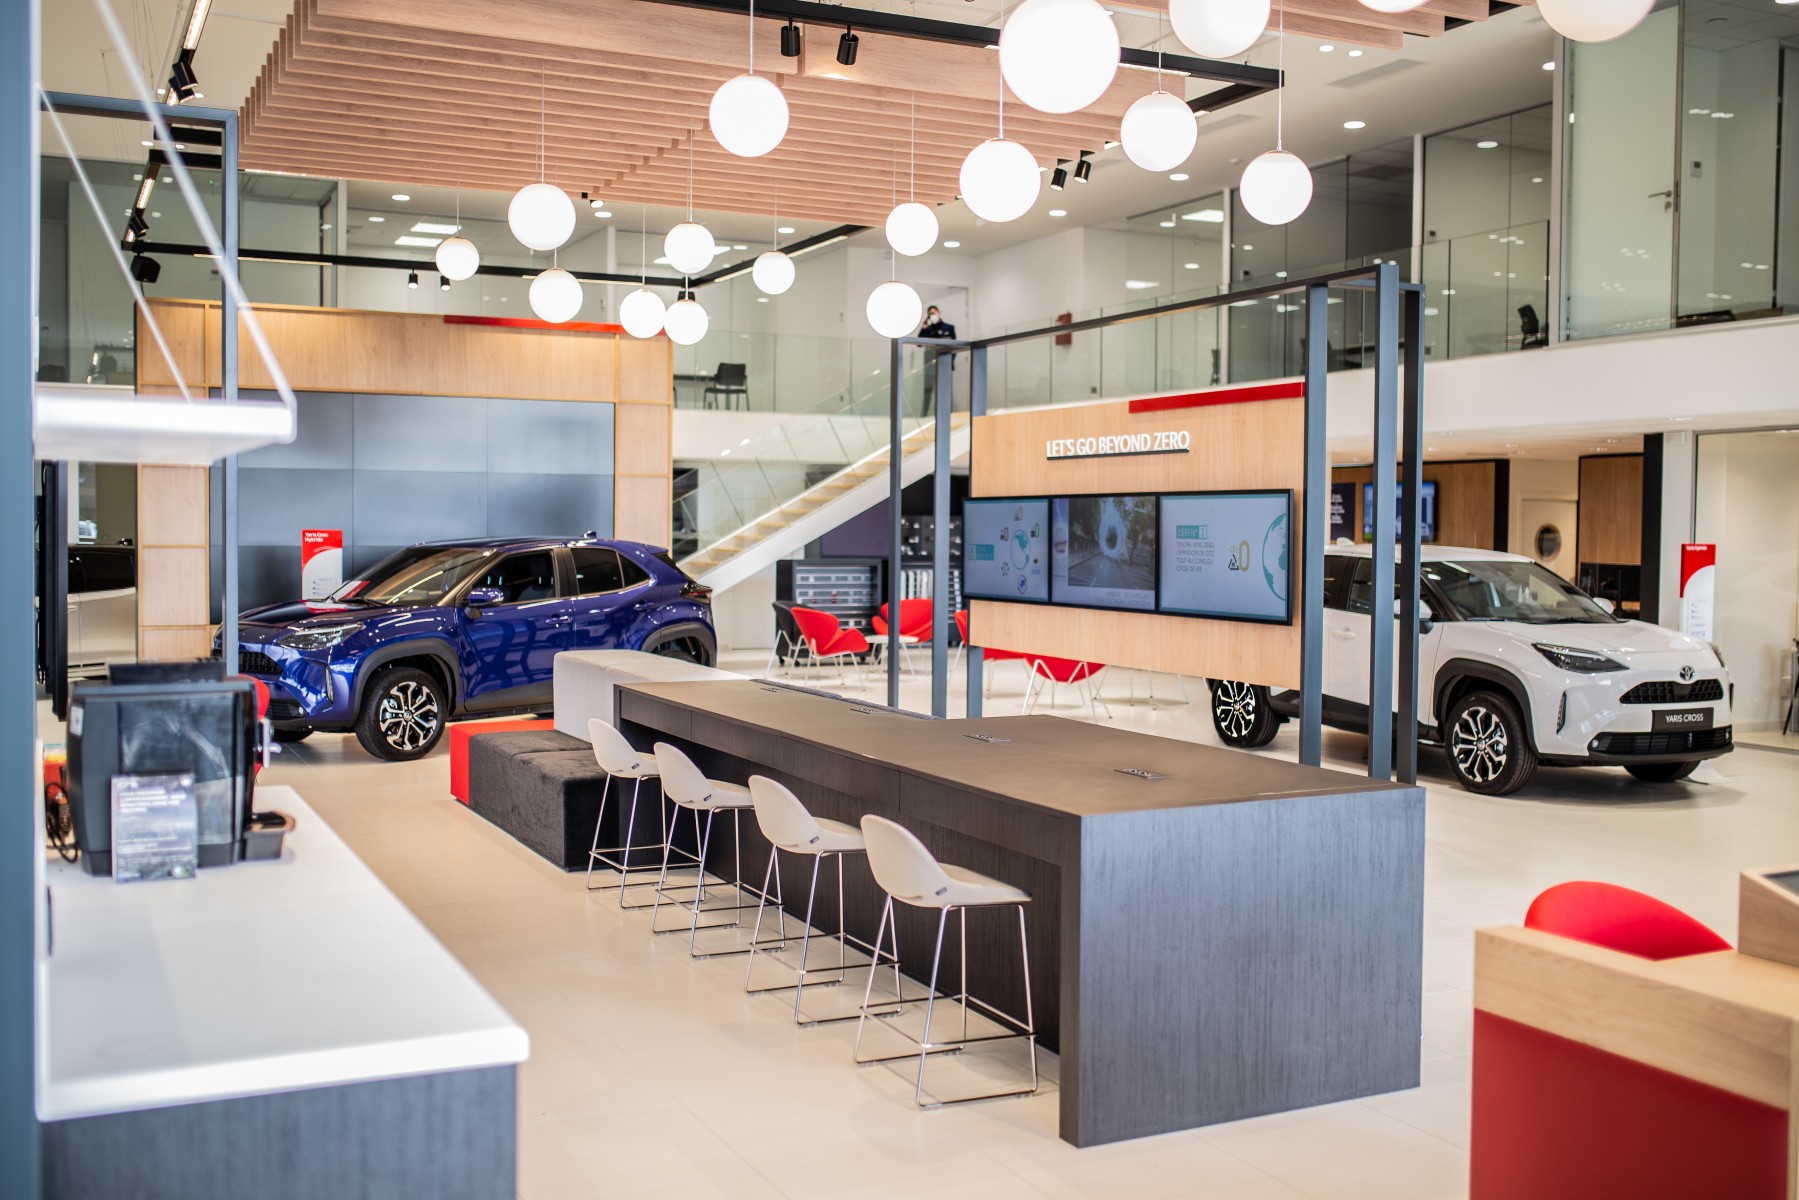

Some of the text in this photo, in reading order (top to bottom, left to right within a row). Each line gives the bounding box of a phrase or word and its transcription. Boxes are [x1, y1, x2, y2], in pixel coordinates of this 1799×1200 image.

[1046, 430, 1190, 457] LET'S GO BEYOND ZERO
[1665, 713, 1704, 723] YARIS CROSS
